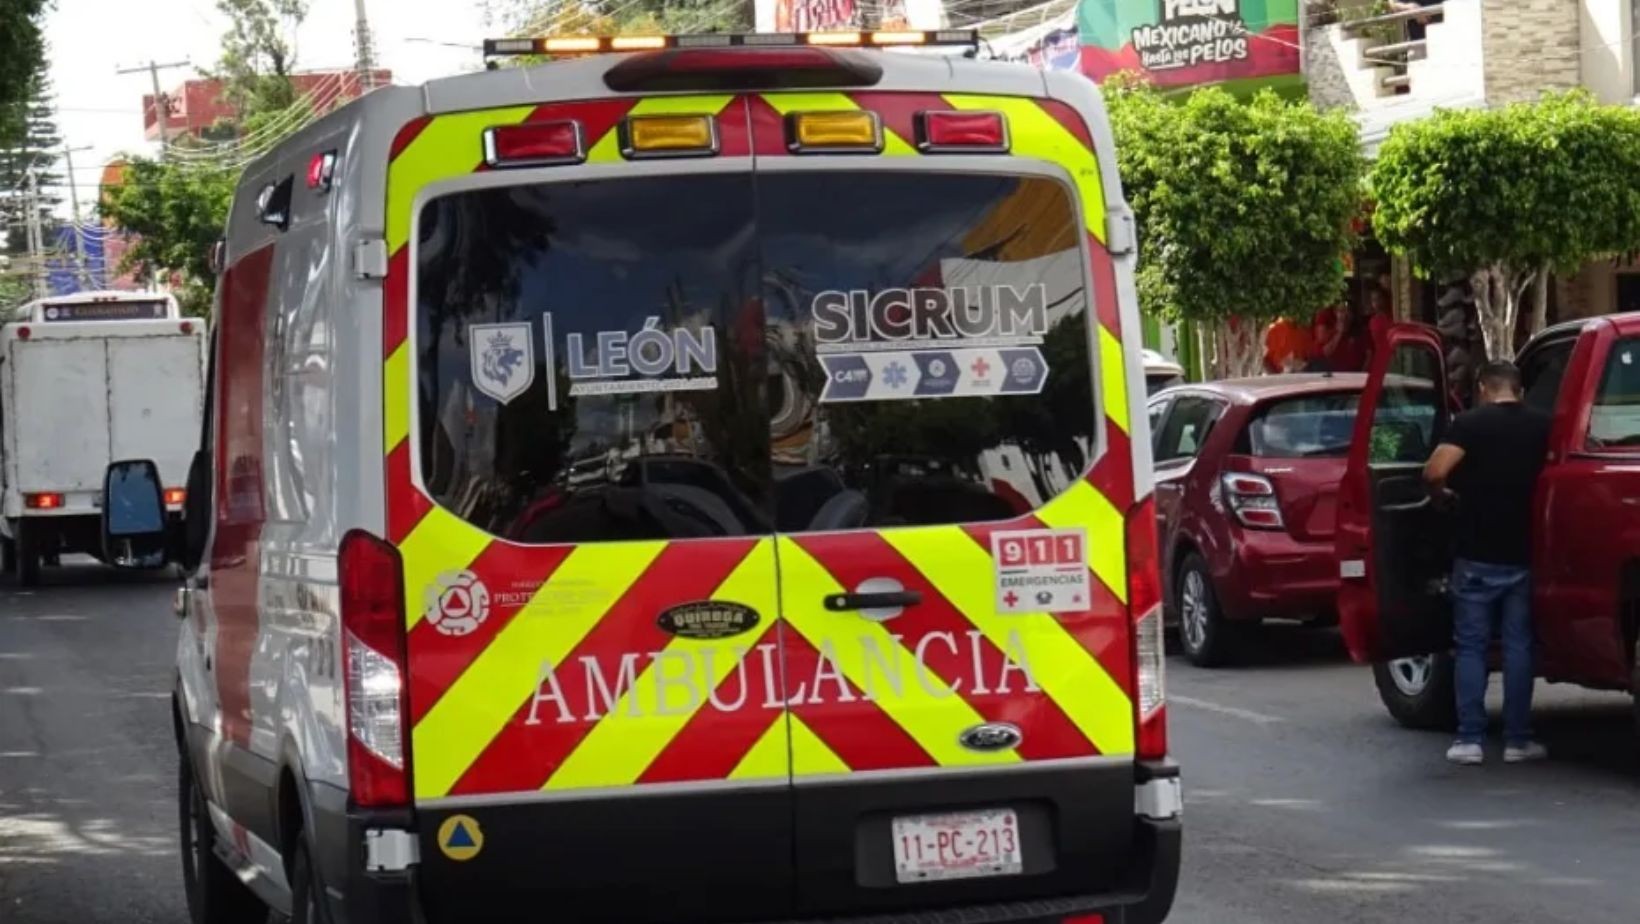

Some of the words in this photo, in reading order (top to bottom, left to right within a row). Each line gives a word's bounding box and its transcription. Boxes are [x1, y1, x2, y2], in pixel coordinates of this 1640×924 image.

[1132, 20, 1226, 51] MEXICANO
[1190, 38, 1247, 65] PELOS
[812, 283, 1049, 342] SICRUM
[566, 316, 717, 378] LEÓN
[1003, 538, 1075, 562] 911
[1000, 573, 1084, 588] EMERGENCIAS
[525, 630, 1038, 725] AMBULANCIA
[901, 828, 1015, 861] 11-PC-213
